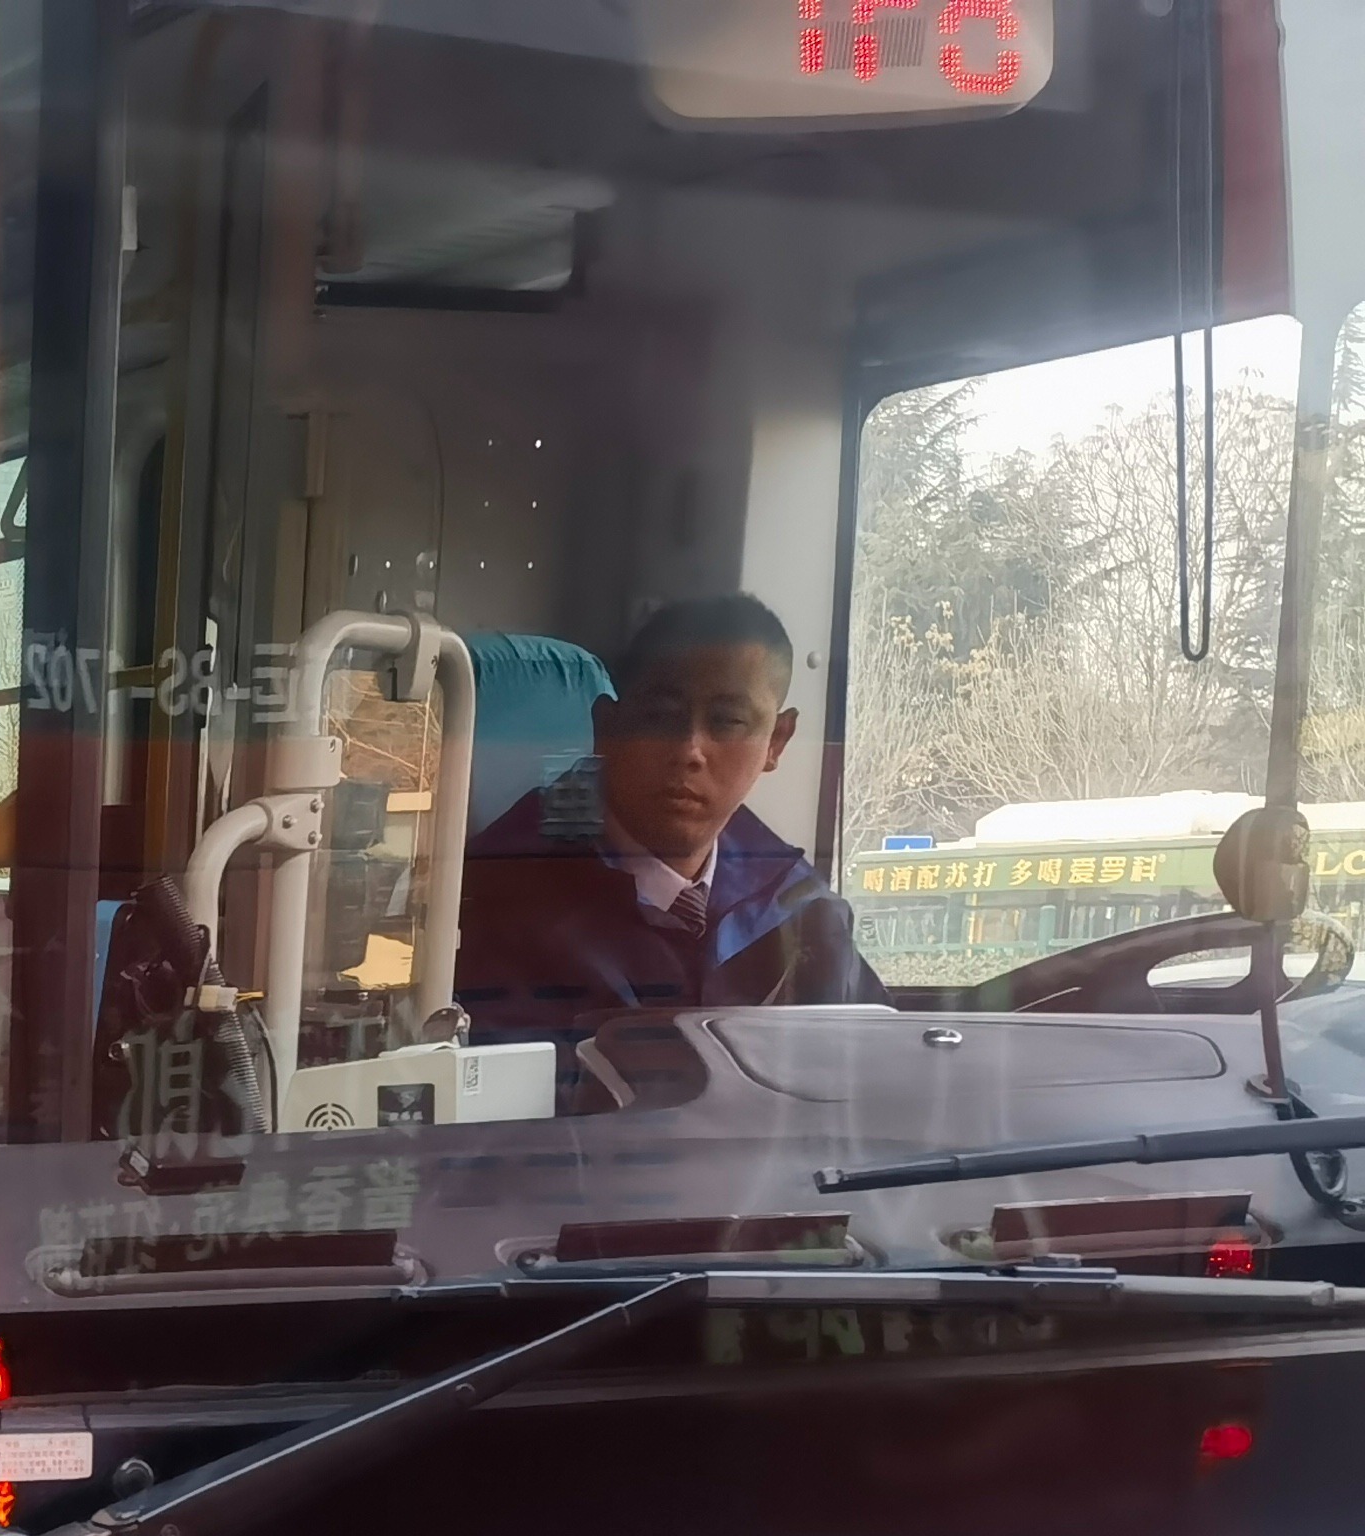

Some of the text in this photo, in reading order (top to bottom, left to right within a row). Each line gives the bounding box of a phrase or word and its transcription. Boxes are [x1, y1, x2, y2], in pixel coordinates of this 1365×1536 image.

[863, 855, 1158, 892] 喝酒配苏打 多喝爱罗科
